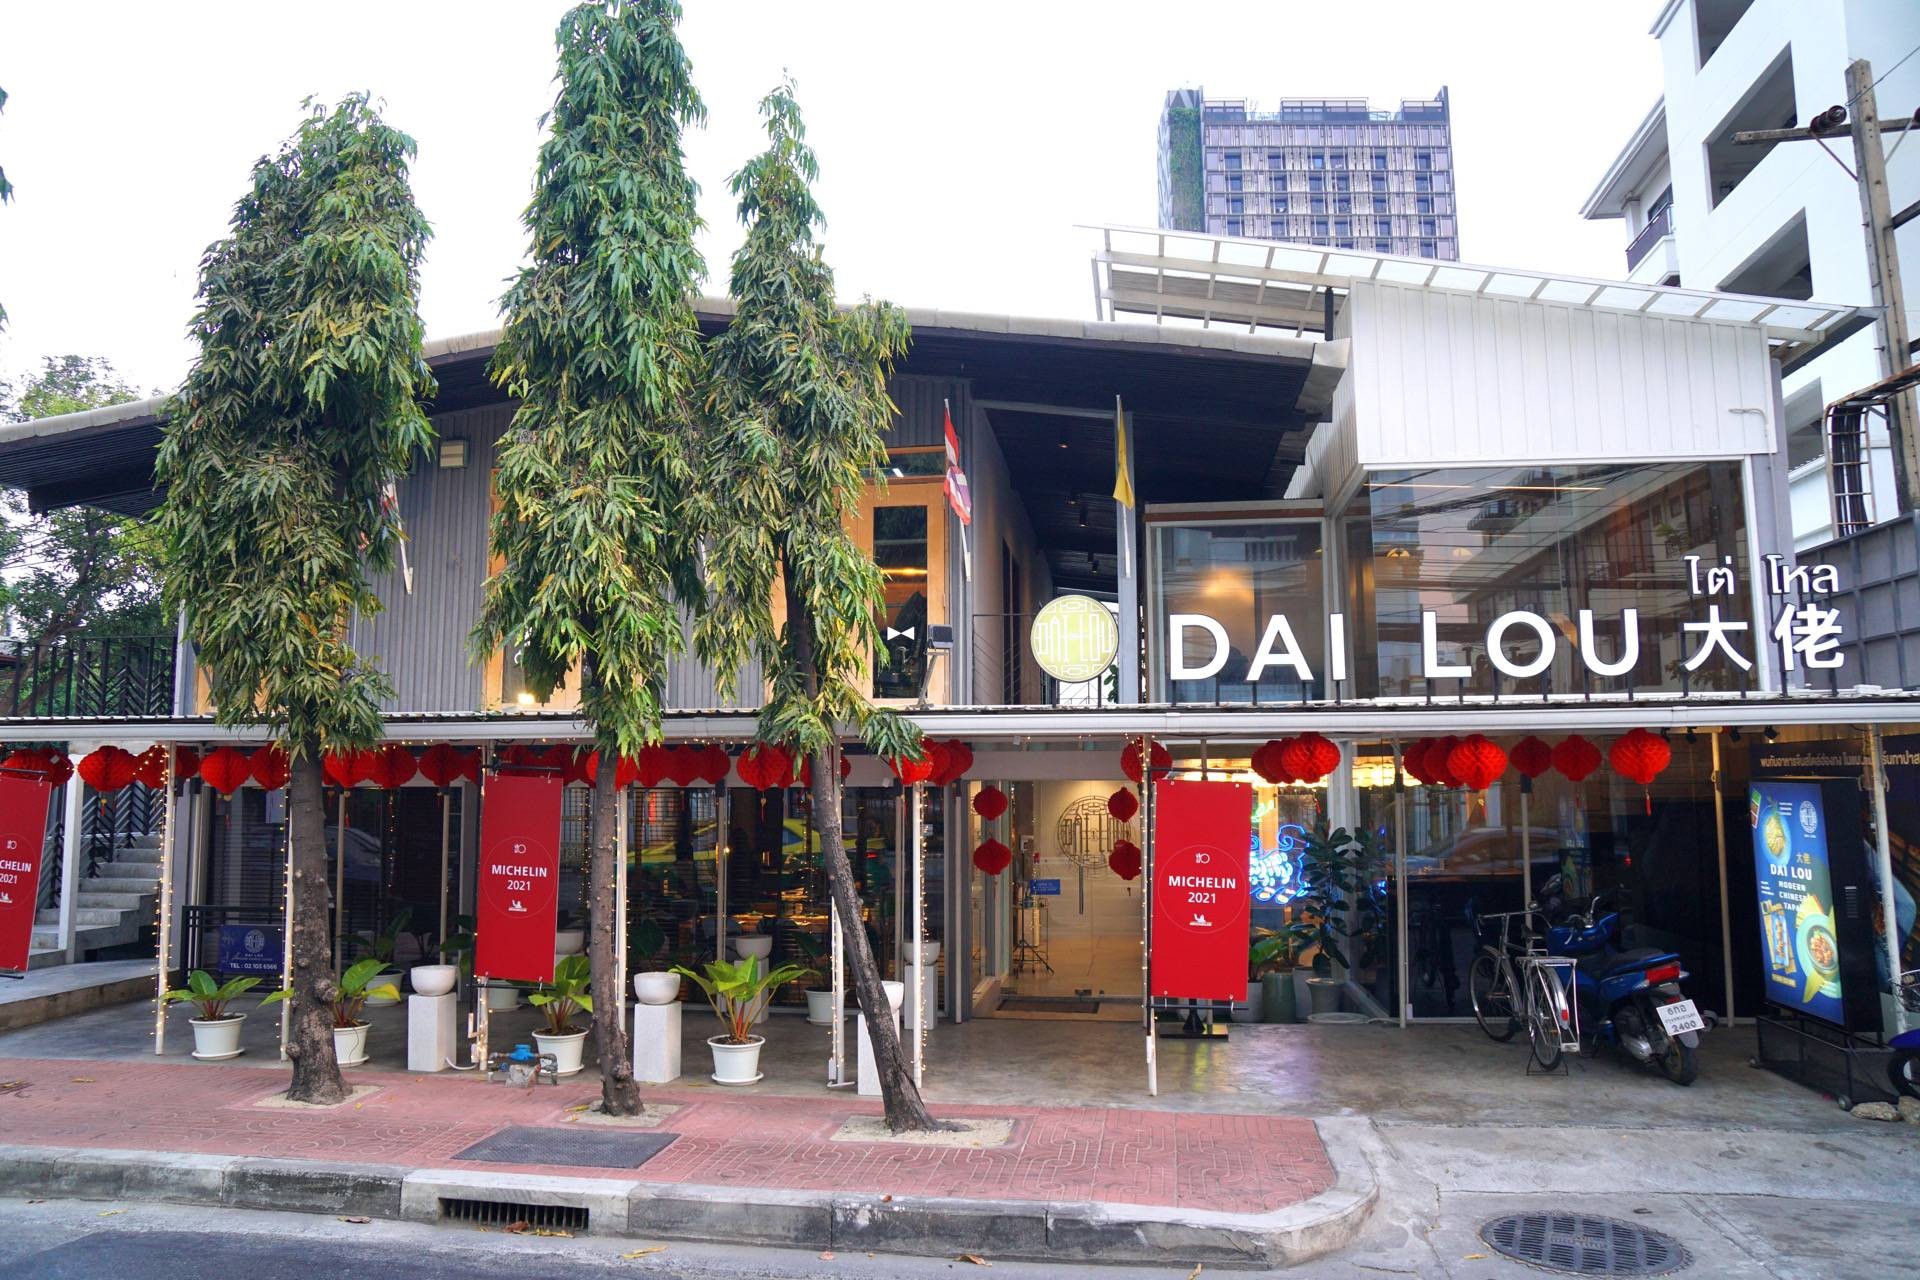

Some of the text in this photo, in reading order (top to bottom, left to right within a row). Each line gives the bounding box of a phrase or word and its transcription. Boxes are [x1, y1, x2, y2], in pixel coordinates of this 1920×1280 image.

[1683, 554, 1839, 595] ไต่ โหล
[1683, 603, 1845, 671] 大佬
[1169, 608, 1640, 681] DAI LOU
[0, 860, 32, 872] CHELIN
[491, 864, 547, 877] MICHELIN
[1770, 863, 1812, 881] DAI LOU
[507, 880, 531, 891] 2021
[1168, 875, 1236, 889] MICHELIN
[1778, 880, 1806, 892] MODERN
[1187, 891, 1216, 904] 2021
[1671, 1020, 1697, 1032] 2400
